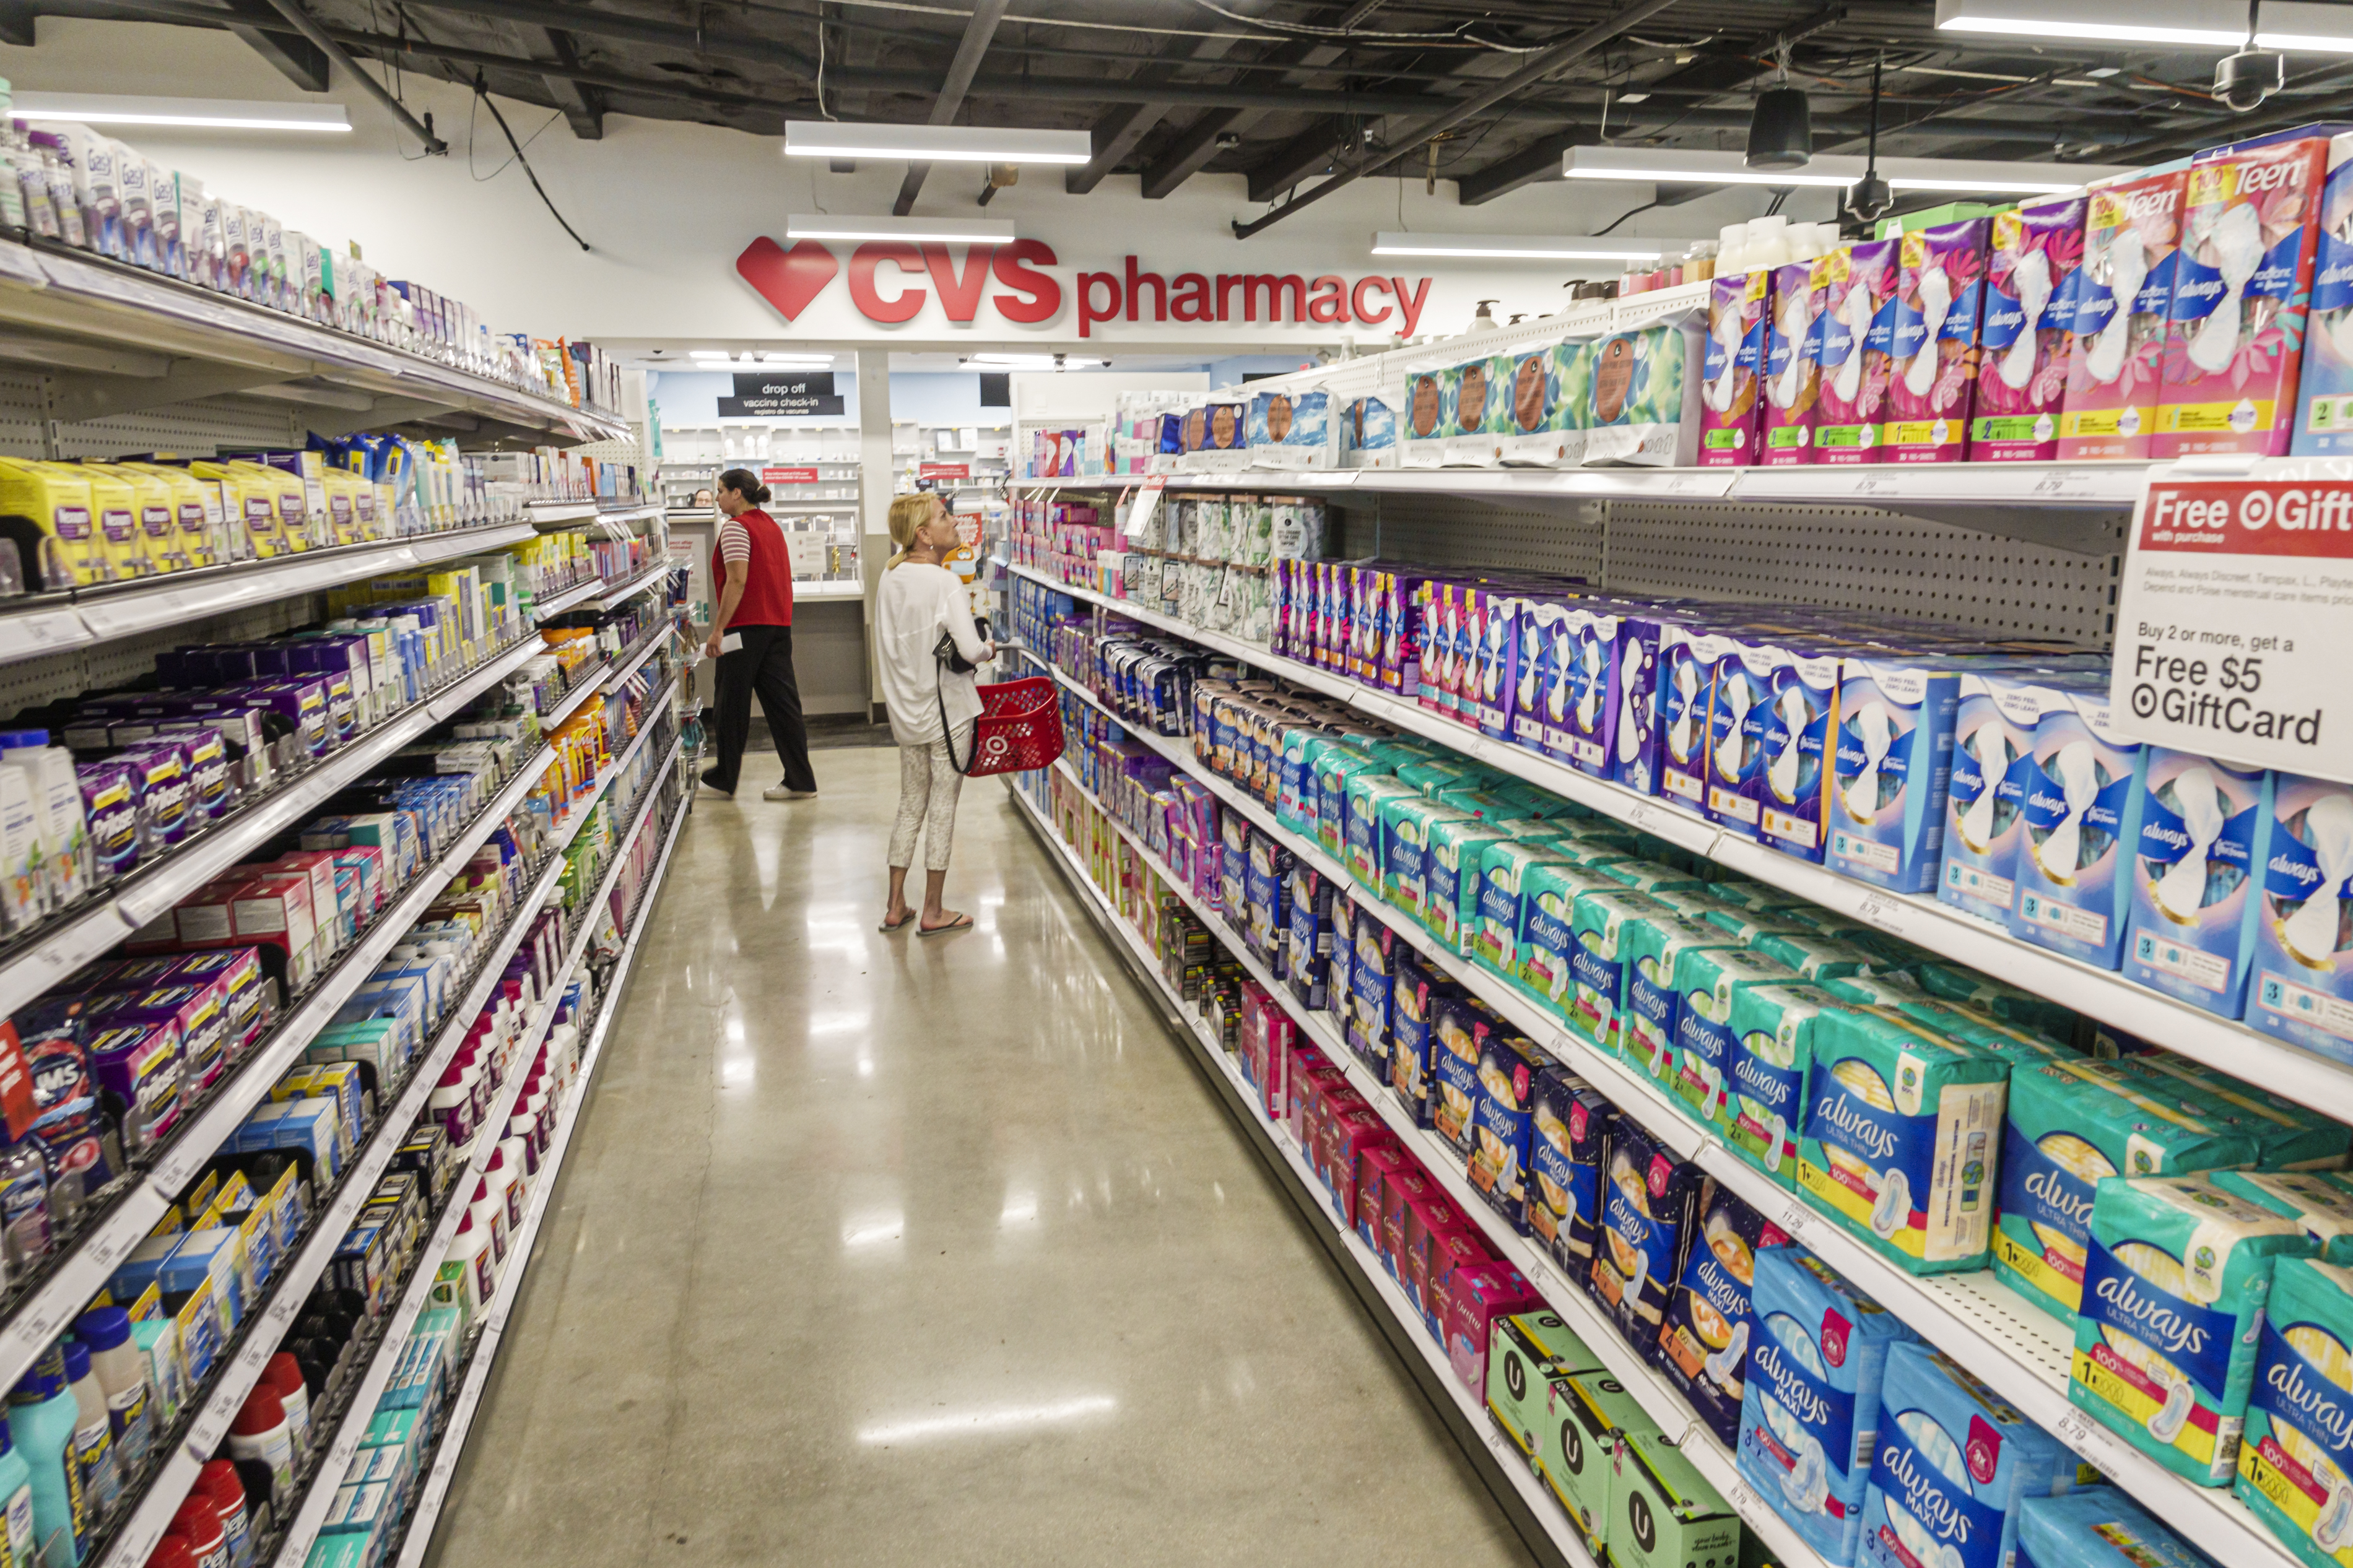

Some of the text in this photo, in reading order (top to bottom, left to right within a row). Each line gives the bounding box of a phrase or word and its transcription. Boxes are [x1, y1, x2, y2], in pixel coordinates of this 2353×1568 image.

[2234, 160, 2303, 196] Teen
[2124, 188, 2179, 219] Teen
[848, 238, 1433, 338] CVS pharmacy
[2079, 294, 2115, 315] always
[2178, 279, 2223, 301] always
[1988, 310, 2023, 330] always
[743, 397, 819, 407] vaccine check-in
[762, 383, 806, 396] drop off
[2153, 490, 2353, 531] Free Gift
[2152, 530, 2225, 544] with purchase
[2177, 584, 2194, 594] and
[2178, 569, 2209, 581] Always
[2138, 622, 2294, 652] Buy 2 or more, get a
[2135, 644, 2263, 693] Free $5
[2162, 688, 2323, 745] GiftCard
[1837, 745, 1866, 767] always
[1953, 768, 1983, 791] always
[2029, 790, 2066, 817] always
[2142, 821, 2188, 850] always
[1393, 842, 1422, 875] always
[2269, 854, 2321, 886] always
[1482, 886, 1515, 922] always
[1530, 913, 1569, 950] always
[1355, 966, 1384, 1003] always
[1573, 951, 1614, 990] always
[1632, 979, 1669, 1020] always
[1681, 1015, 1726, 1059] always
[1442, 1055, 1474, 1091] always
[1735, 1057, 1791, 1106] always
[1480, 1096, 1514, 1138] always
[1818, 1093, 1900, 1159] always
[1826, 1124, 1848, 1144] ULTRA
[2025, 1169, 2094, 1226] alwa
[2037, 1202, 2067, 1226] ULTRA
[1430, 1276, 1451, 1302] Carefree
[1697, 1261, 1748, 1315] always
[1708, 1290, 1726, 1311] MAXI
[1457, 1300, 1482, 1330] Carefree
[2096, 1276, 2211, 1354] always
[2107, 1306, 2164, 1348] ULTRA THIN
[1510, 1359, 1521, 1391] U
[1755, 1345, 1831, 1425] always
[2083, 1361, 2092, 1383] 1
[1775, 1384, 1800, 1416] MAXI
[2268, 1363, 2353, 1451] alway
[2058, 1416, 2087, 1441] 8.79
[2276, 1395, 2330, 1444] ULTRA THIN
[1566, 1429, 1578, 1463] U
[1884, 1446, 1973, 1544] always
[1905, 1491, 1935, 1530] MAXI
[1635, 1502, 1650, 1540] U
